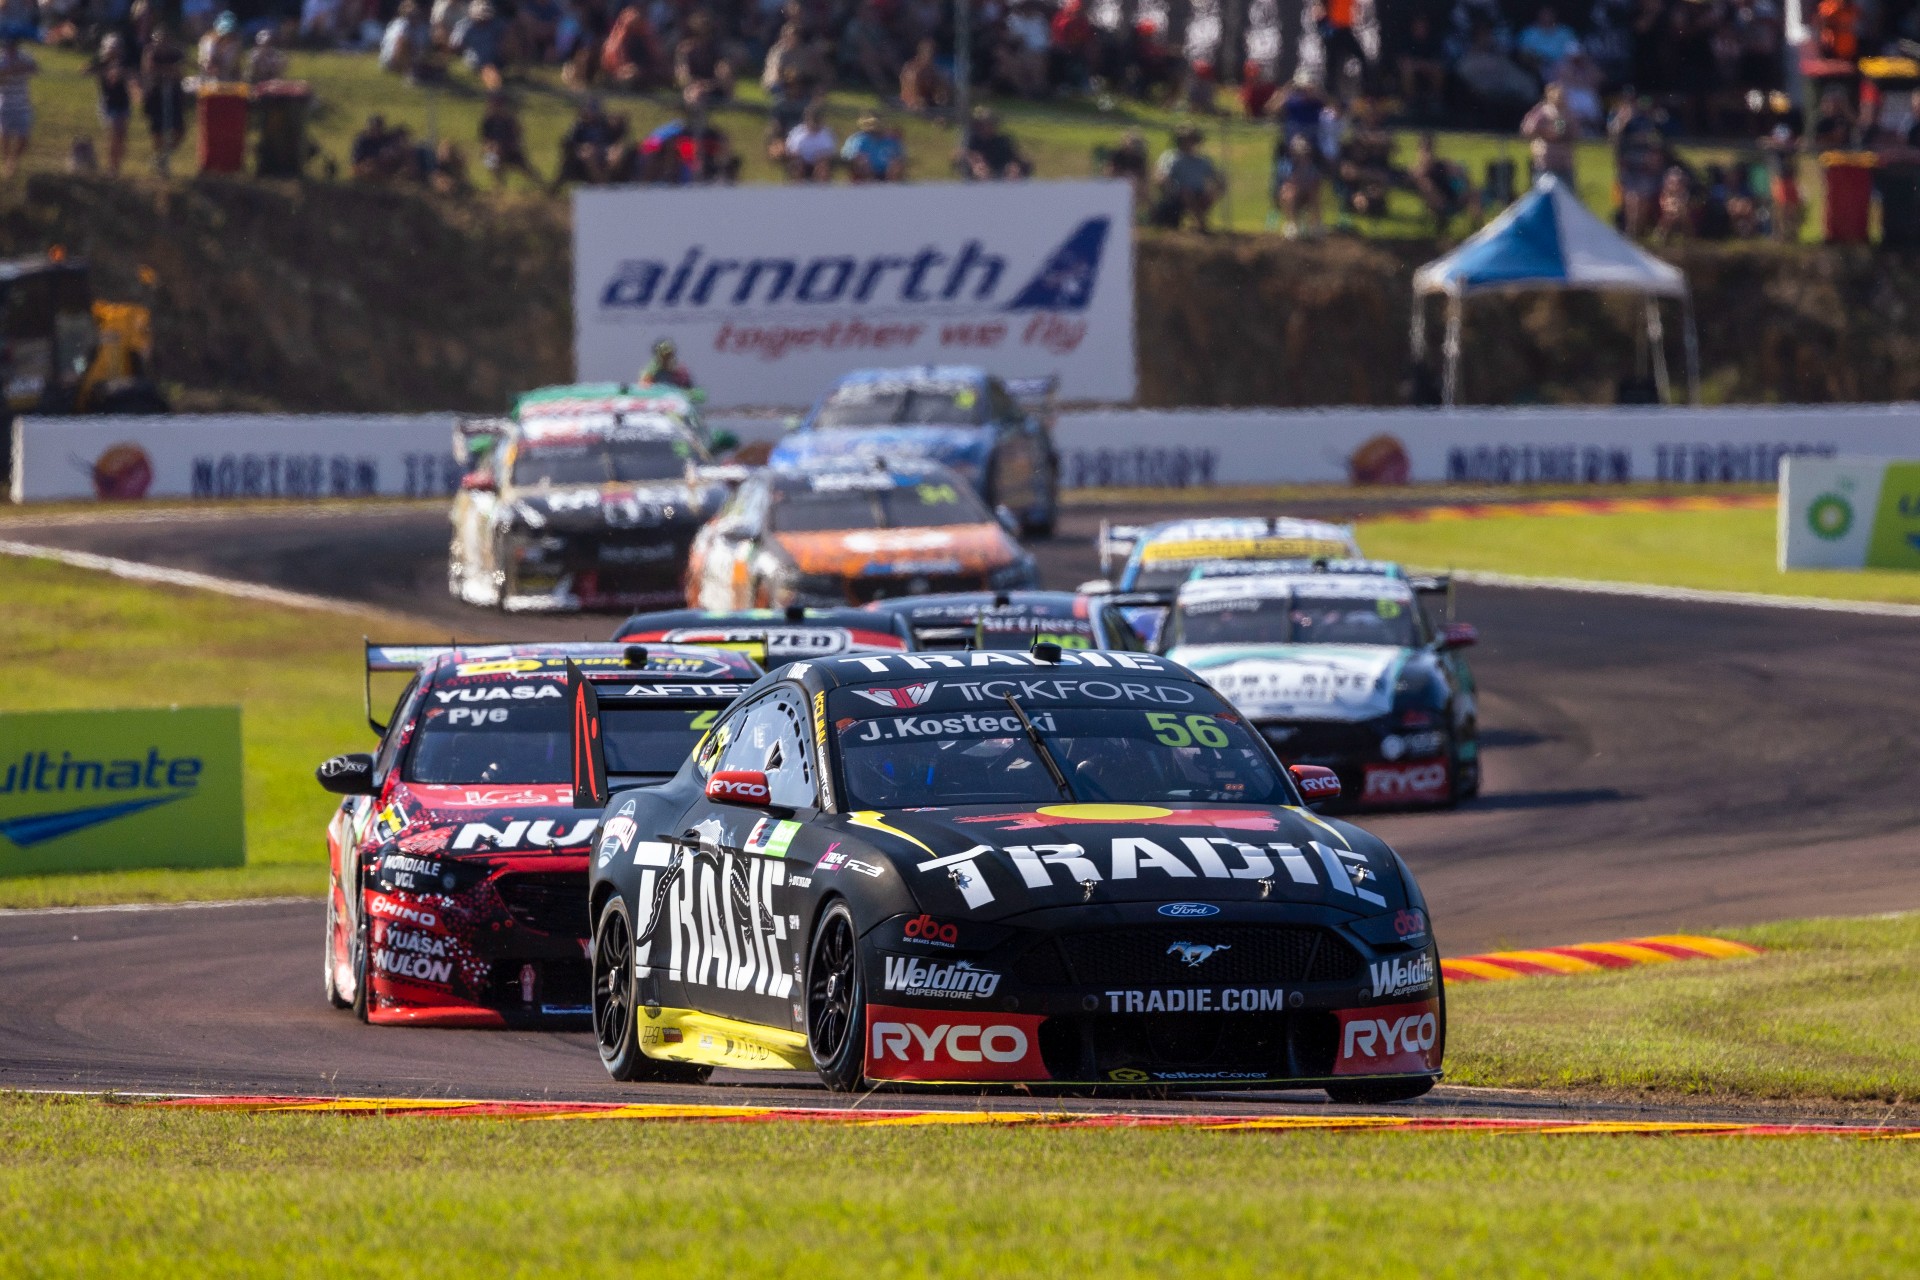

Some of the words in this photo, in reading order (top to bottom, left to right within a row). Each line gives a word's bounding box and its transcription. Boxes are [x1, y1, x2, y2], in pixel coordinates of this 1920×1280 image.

[600, 240, 1007, 307] airnorth
[714, 316, 926, 360] together
[939, 322, 1006, 351] we
[1021, 313, 1090, 353] fly
[192, 453, 379, 496] NORTHERN
[1447, 444, 1632, 483] NORTHERN
[838, 651, 1165, 673] TRADIE
[435, 685, 562, 703] YUASA
[625, 684, 753, 696] AFTE
[448, 707, 509, 726] Pye
[1145, 712, 1229, 748] 56
[709, 780, 768, 797] RYCO
[1300, 776, 1341, 792] RYCO
[1366, 764, 1446, 795] RYCO
[383, 855, 441, 877] MONDIALE
[917, 837, 1387, 910] TRADIE
[395, 871, 415, 889] VGL
[382, 901, 436, 927] HINO
[1168, 903, 1209, 915] Ford
[386, 926, 446, 957] YUASA
[904, 914, 958, 943] dba
[930, 940, 955, 949] AUSTRALIA
[375, 947, 453, 983] NULON
[884, 956, 1001, 998] Welding
[905, 987, 974, 1000] SUPERSTORE
[1105, 988, 1283, 1013] TRADIE.COM
[872, 1021, 1029, 1063] RYCO
[1343, 1012, 1437, 1059] RYCO
[1152, 1070, 1268, 1080] YellowCover
